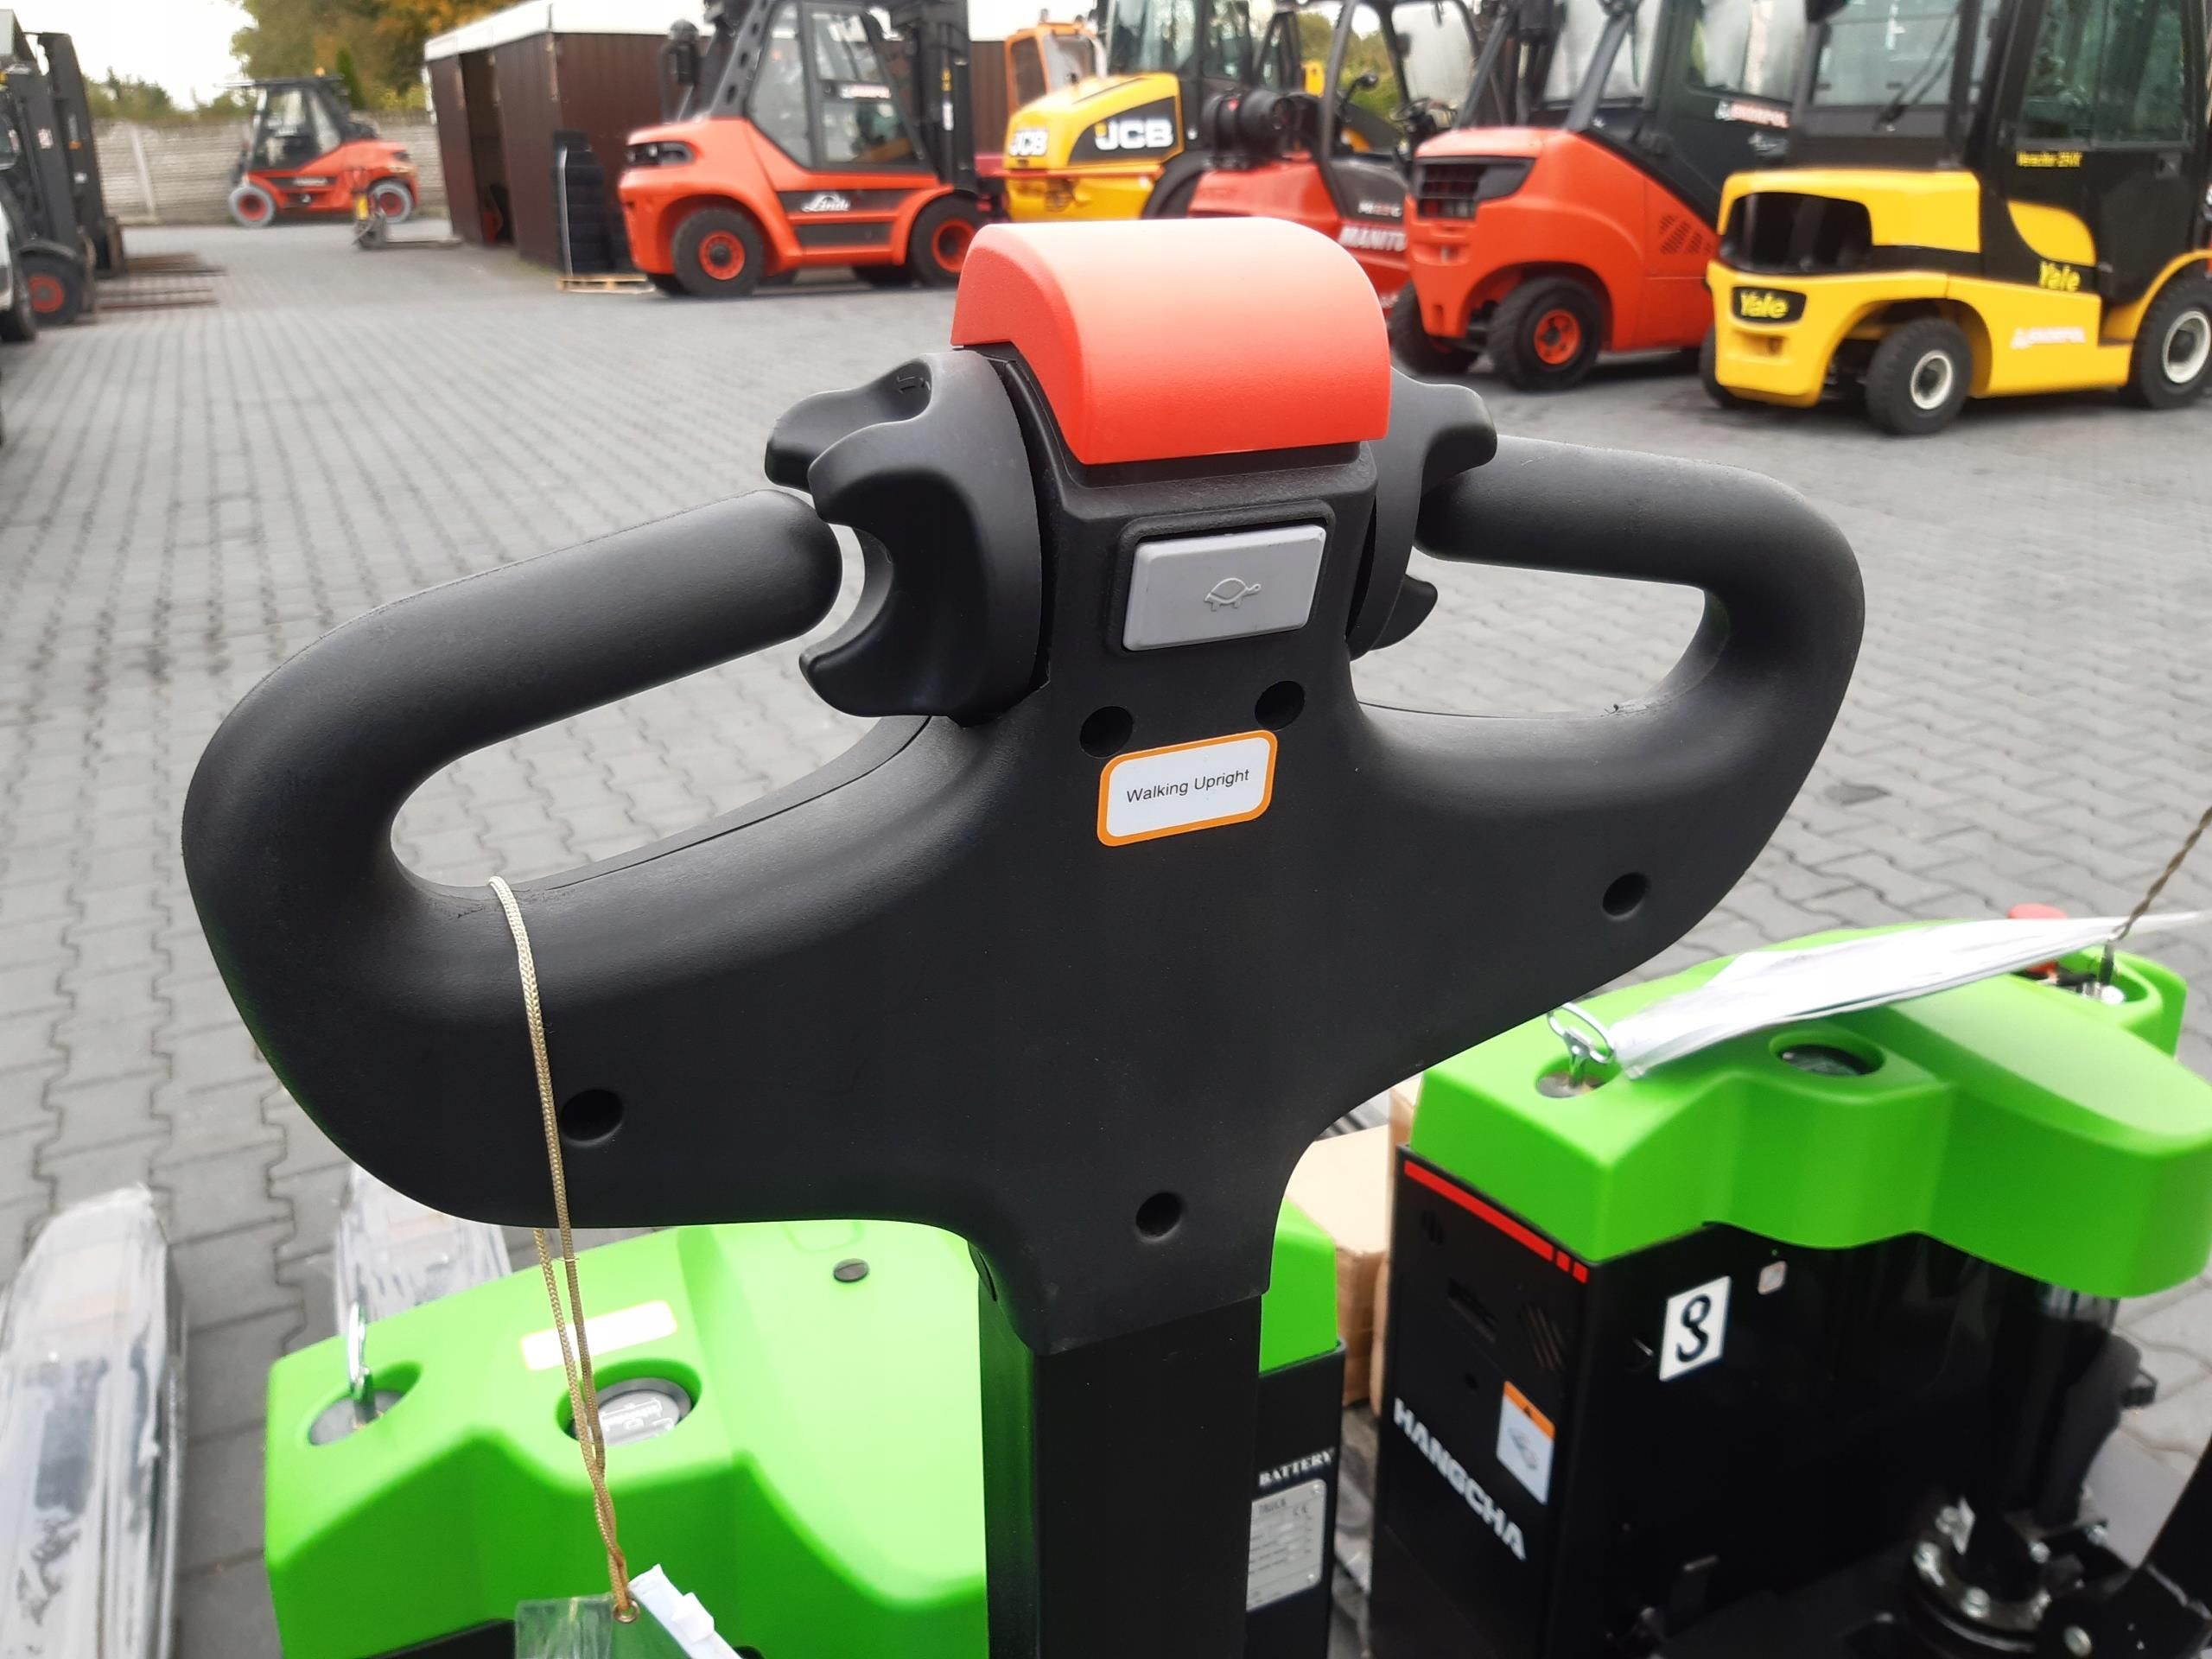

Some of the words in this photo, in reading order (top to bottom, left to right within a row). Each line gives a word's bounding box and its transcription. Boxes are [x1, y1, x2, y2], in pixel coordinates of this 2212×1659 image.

[1094, 118, 1173, 150] JCB
[2039, 261, 2081, 292] Yale
[1740, 291, 1789, 319] Yale
[1127, 782, 1189, 803] Walking
[1194, 769, 1250, 791] Upright
[1259, 1447, 1334, 1486] BATTERY
[1393, 1397, 1527, 1560] HANGCHA
